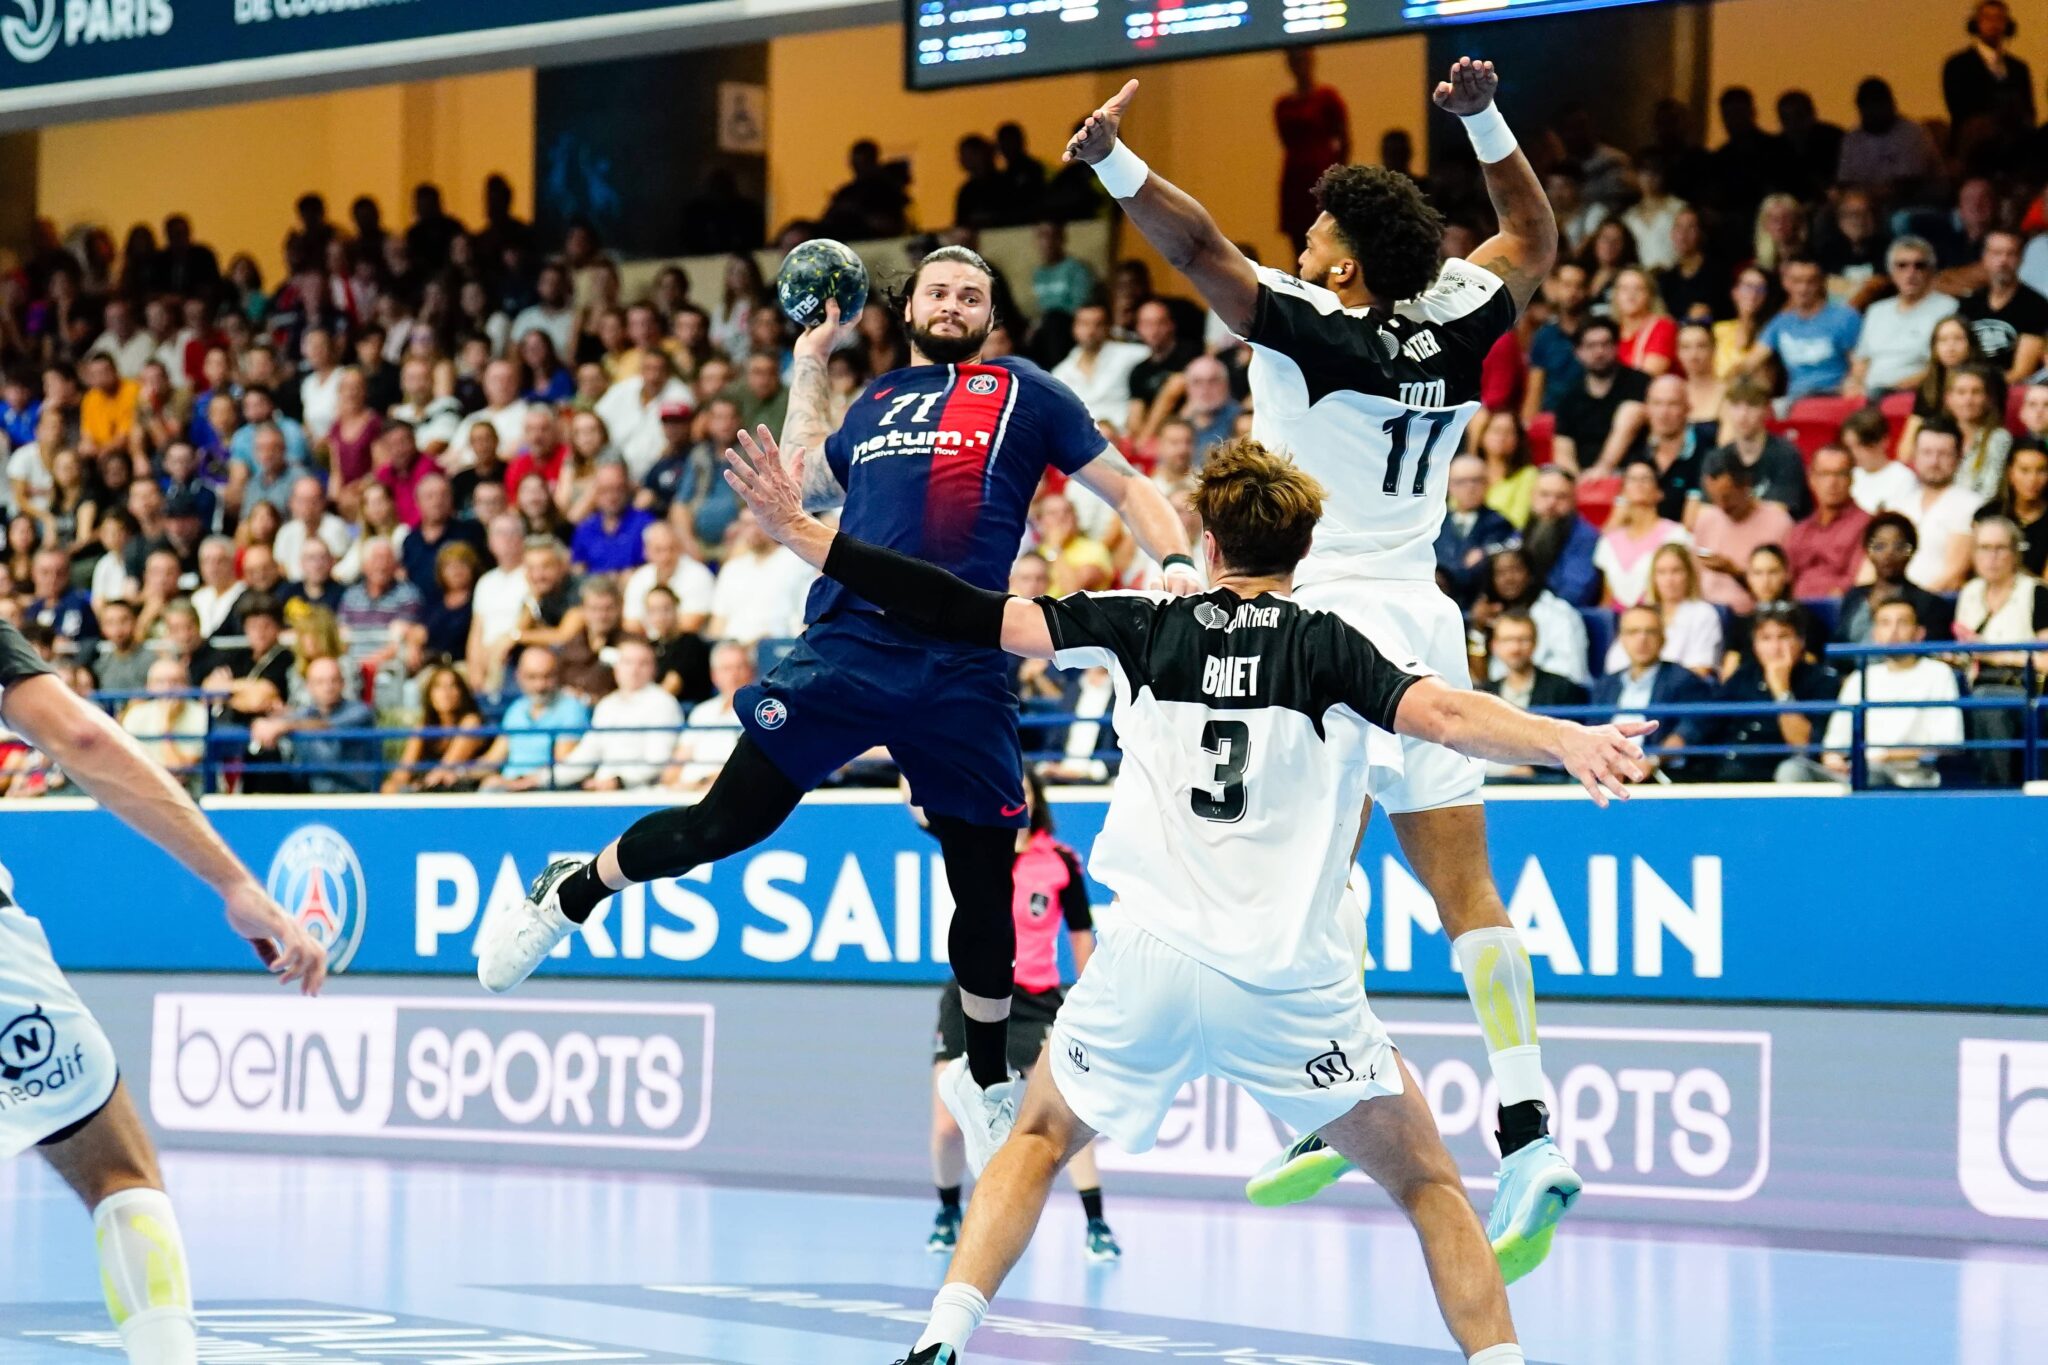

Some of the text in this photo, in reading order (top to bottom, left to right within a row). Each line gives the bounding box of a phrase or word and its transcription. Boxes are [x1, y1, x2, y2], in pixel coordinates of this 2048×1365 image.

[64, 0, 174, 46] PARIS
[878, 391, 943, 426] 71
[1399, 379, 1445, 408] TOTO
[934, 447, 959, 456] flow
[1382, 409, 1456, 497] 17
[1190, 720, 1251, 823] 3
[741, 849, 957, 963] SAI
[0, 1043, 84, 1110] neodif
[405, 1027, 684, 1129] SPORTS
